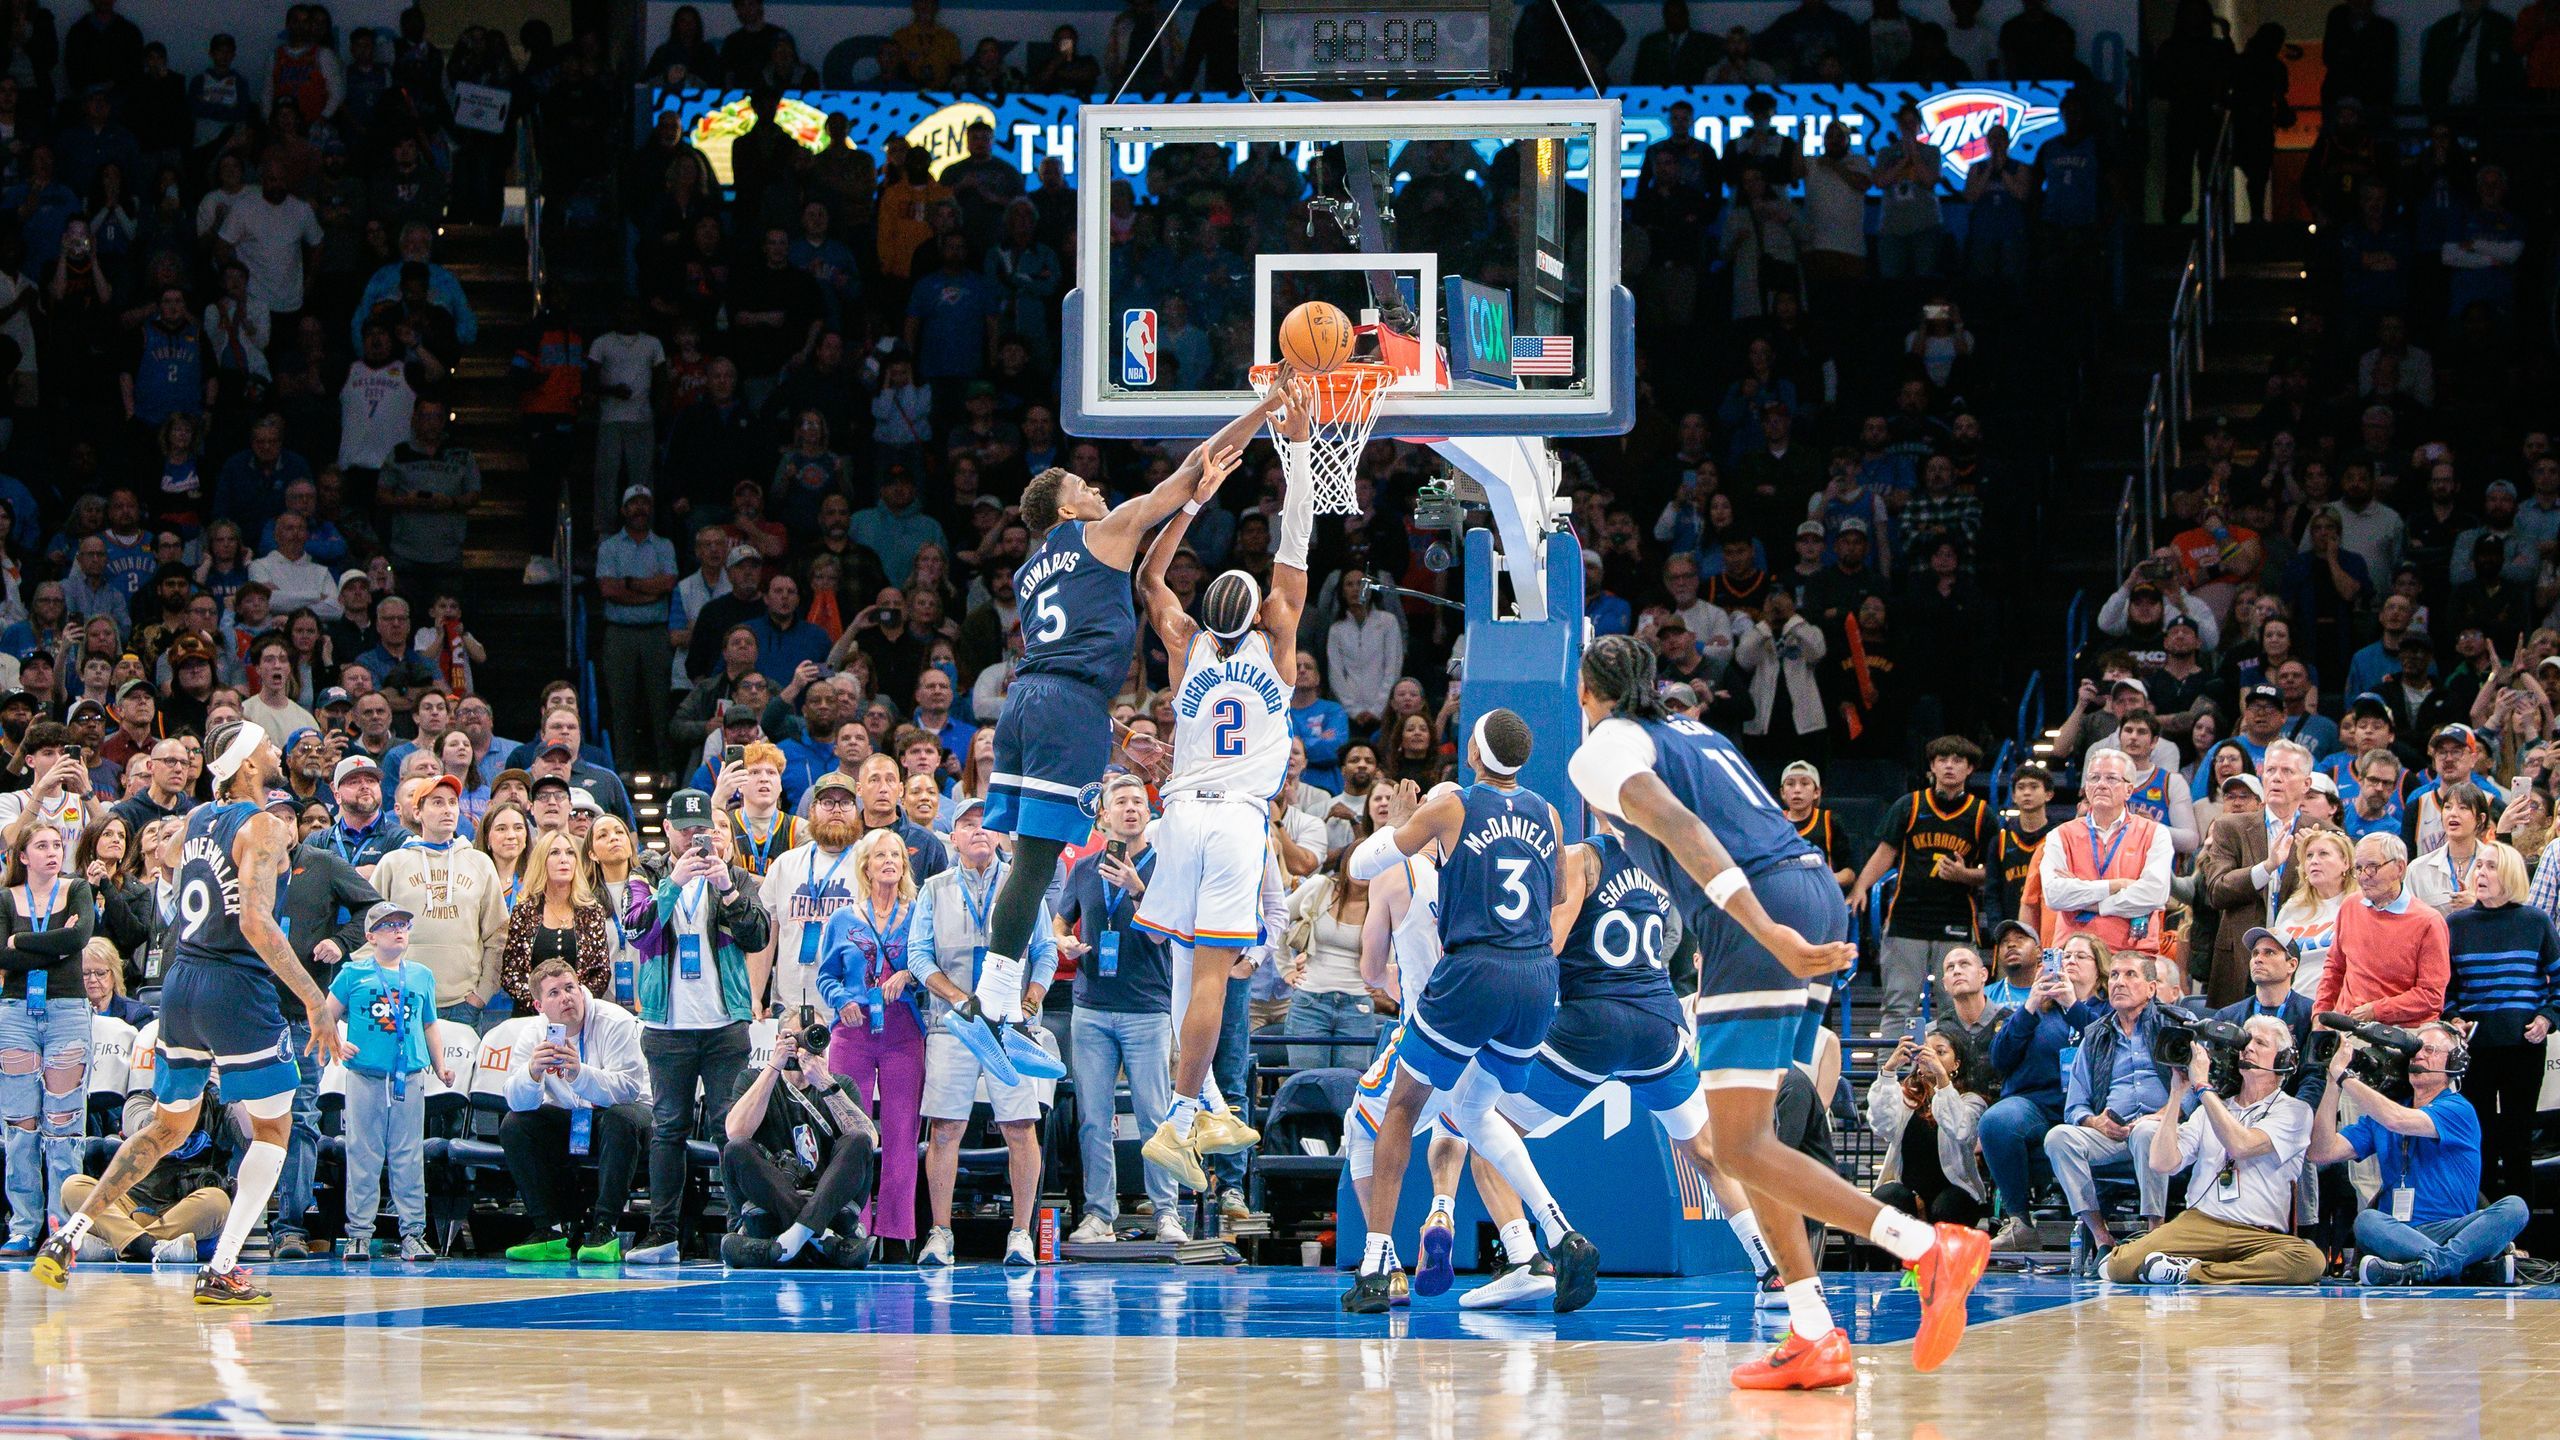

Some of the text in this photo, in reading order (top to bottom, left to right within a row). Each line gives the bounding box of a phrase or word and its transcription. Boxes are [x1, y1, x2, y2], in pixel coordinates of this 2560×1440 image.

[1469, 295, 1506, 364] COX
[1127, 367, 1144, 380] NBA
[1020, 551, 1080, 600] EDWARDS
[1037, 584, 1067, 643] 5
[1181, 661, 1283, 719] GILGEOUS-ALEXANDER
[1213, 697, 1246, 759] 2
[1702, 748, 1782, 808] 11
[1463, 815, 1555, 860] McDANIELS
[181, 879, 210, 941] 9
[456, 873, 474, 890] CITY
[1494, 858, 1531, 922] 3
[1594, 909, 1664, 970] 00
[1041, 1217, 1053, 1255] POPCORN
